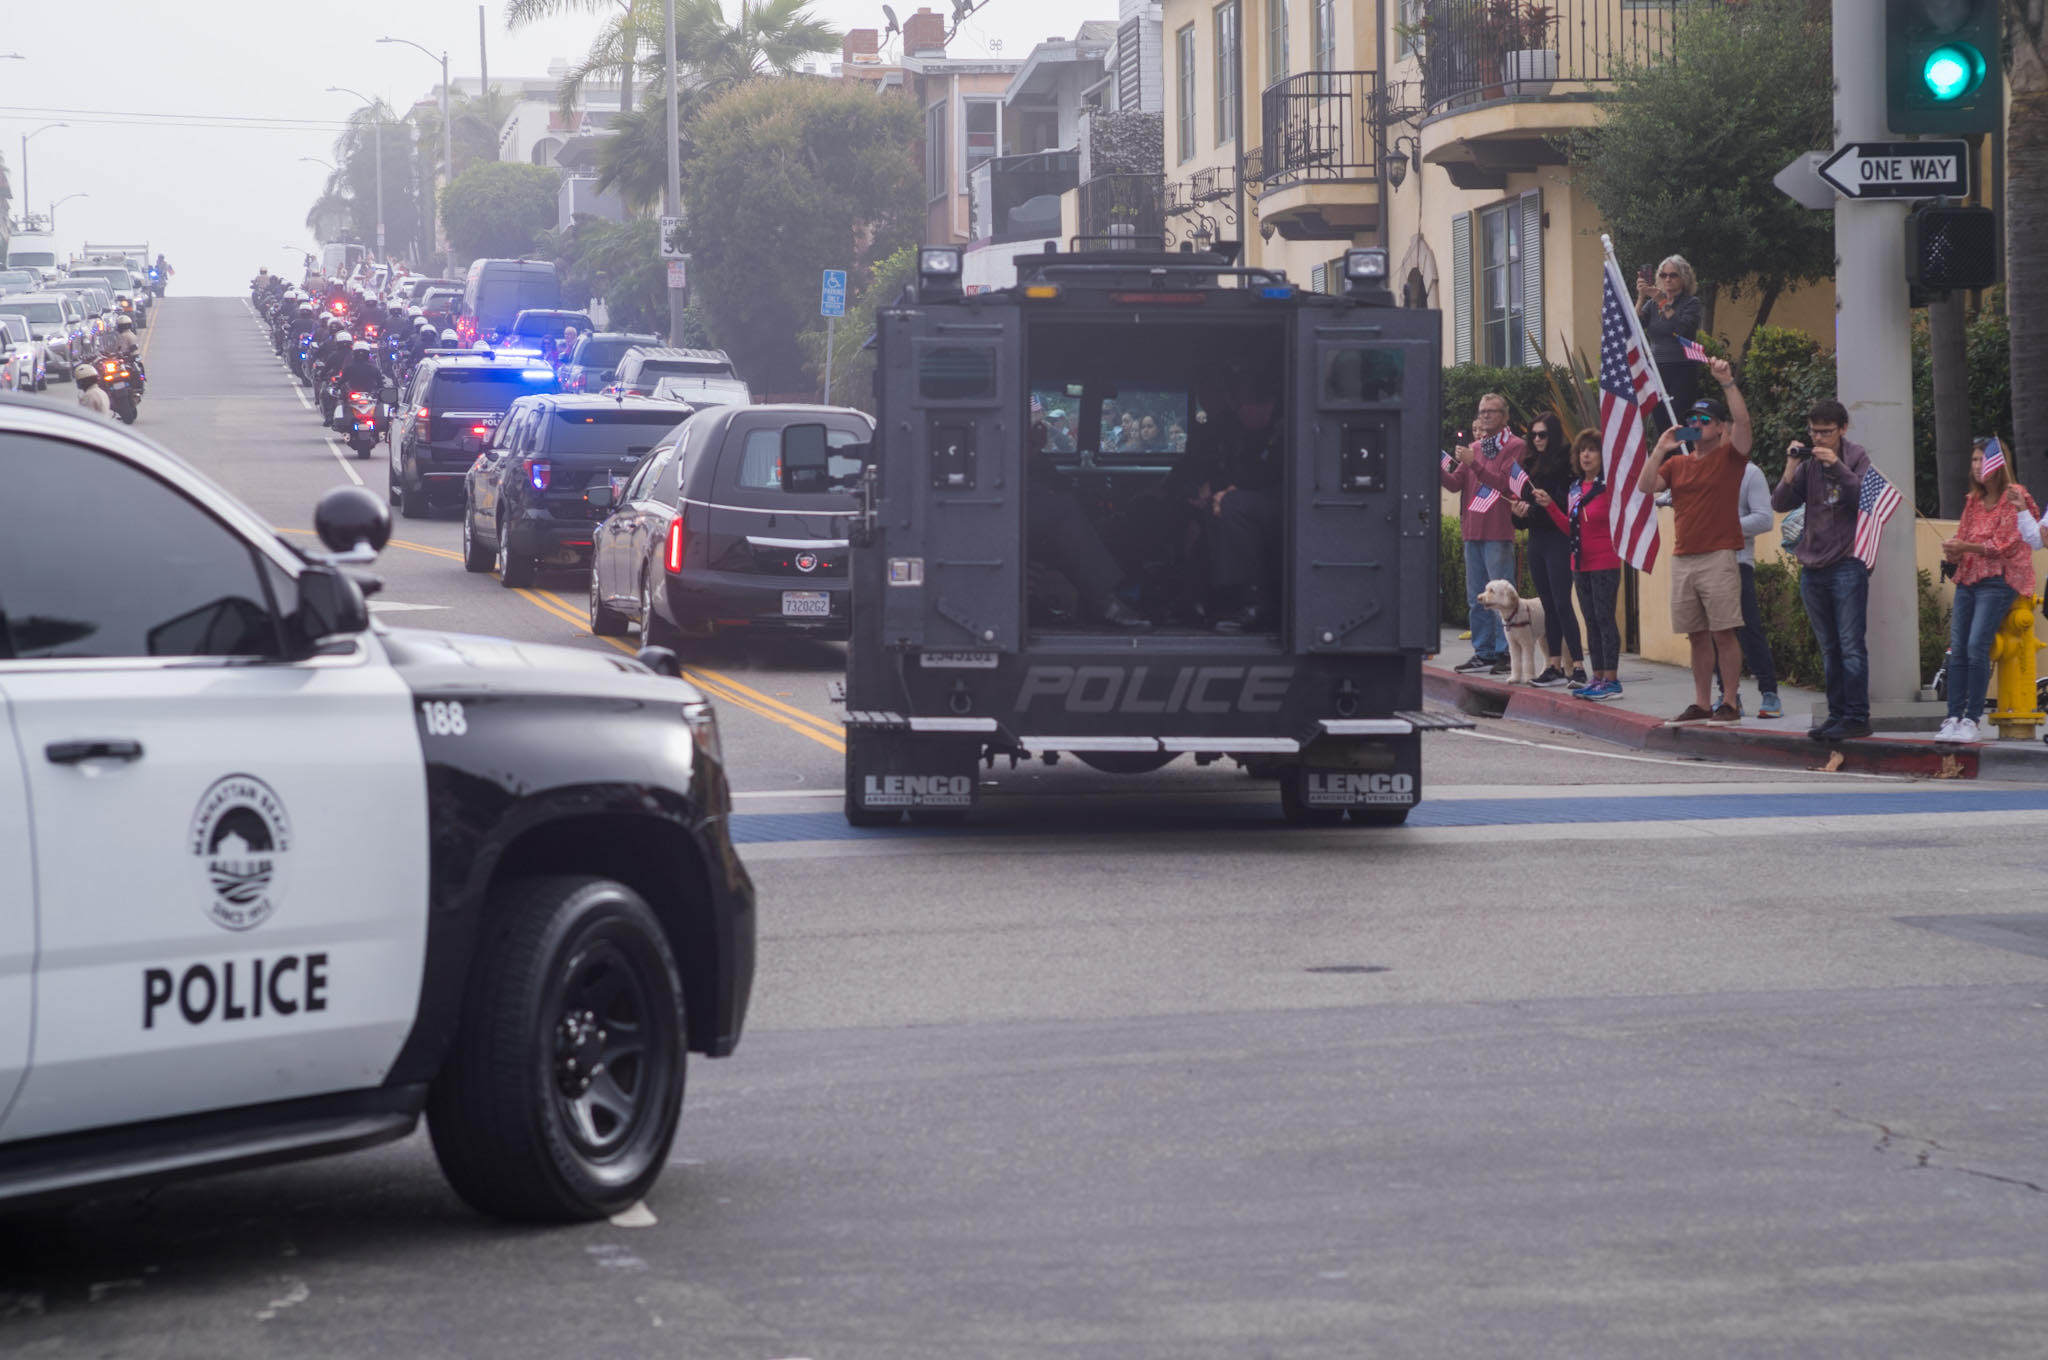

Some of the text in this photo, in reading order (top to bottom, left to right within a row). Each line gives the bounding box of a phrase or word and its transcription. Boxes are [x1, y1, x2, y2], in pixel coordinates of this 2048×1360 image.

[1860, 158, 1952, 181] ONE WAY
[1012, 665, 1296, 712] POLICE
[421, 701, 467, 735] 188
[864, 775, 971, 794] LENCO
[1308, 773, 1413, 793] LENCO
[1366, 794, 1412, 803] VEHICLES
[142, 952, 328, 1030] POLICE
